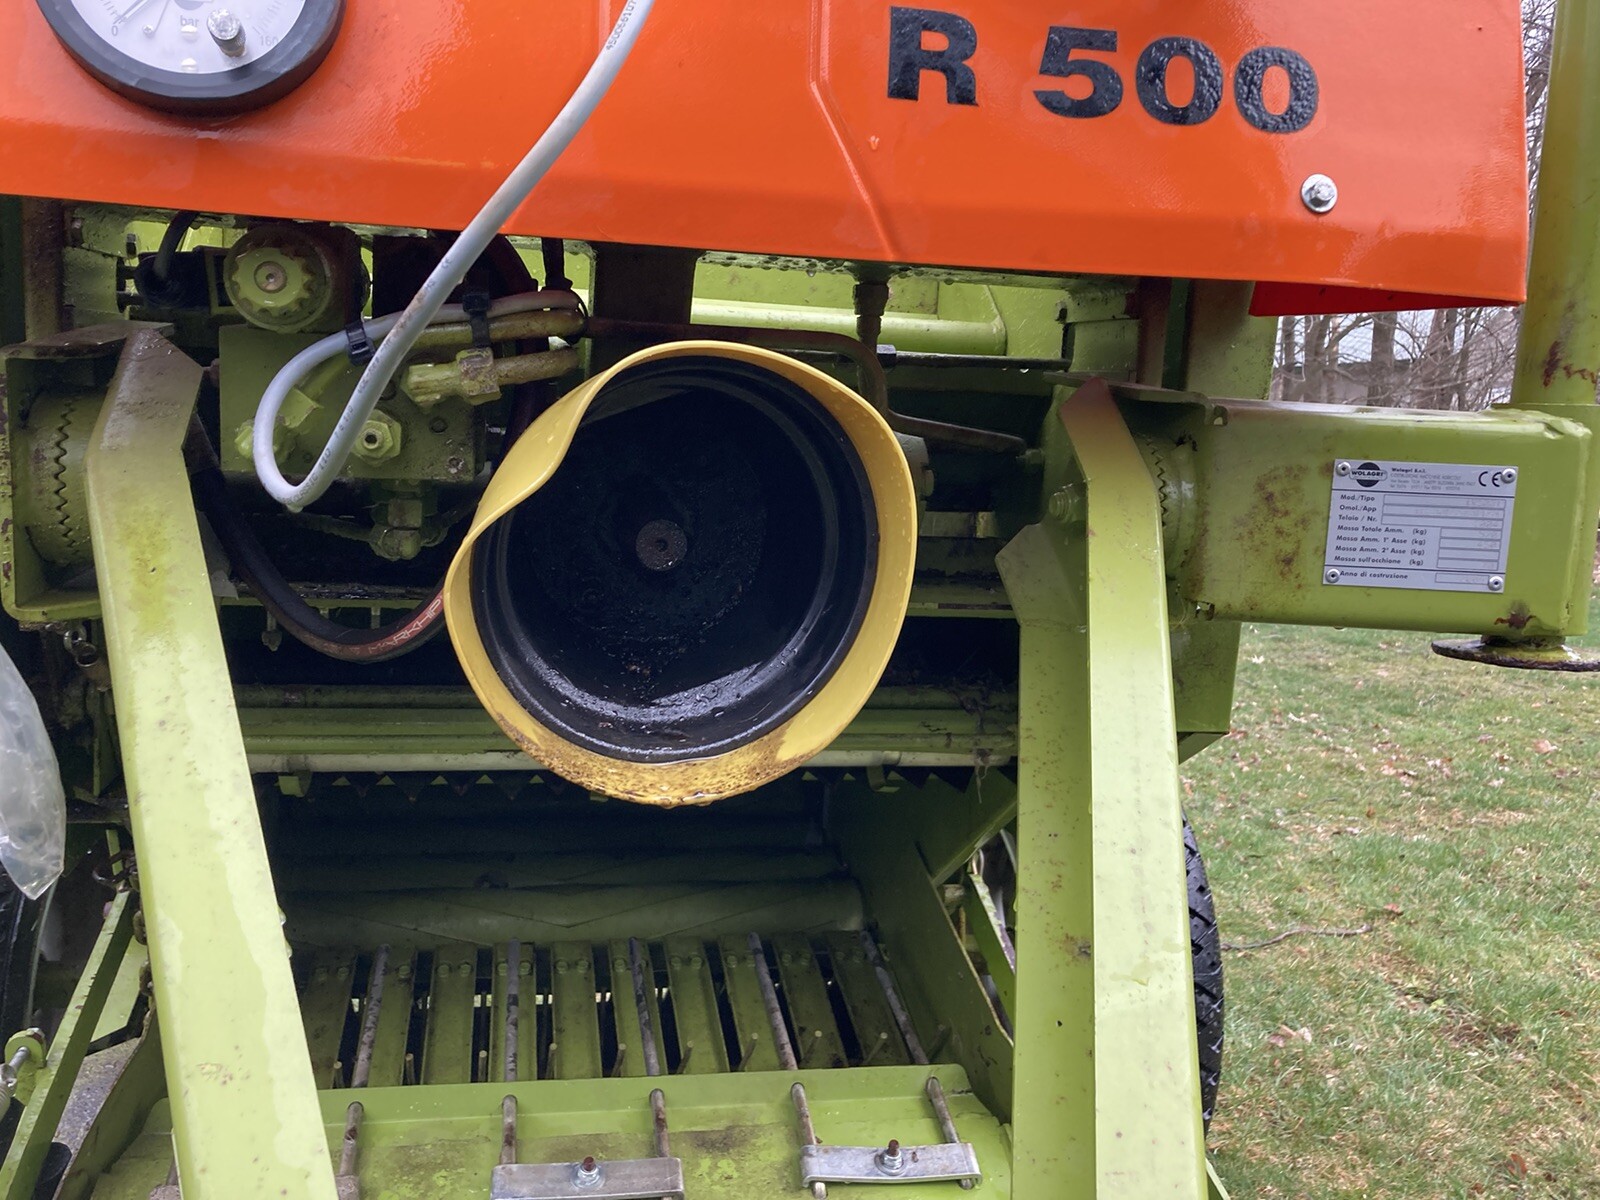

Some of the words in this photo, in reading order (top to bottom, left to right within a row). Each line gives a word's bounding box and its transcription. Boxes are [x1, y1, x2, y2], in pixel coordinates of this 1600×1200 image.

[180, 15, 199, 27] bar
[111, 25, 118, 37] 0
[888, 6, 978, 106] R
[1033, 26, 1319, 133] 500
[1478, 471, 1502, 487] CE
[1340, 494, 1375, 502] Mod./Tipo
[1340, 504, 1377, 512] Omol./App
[1411, 538, 1426, 546] (kg)
[1410, 548, 1425, 556] (kg)
